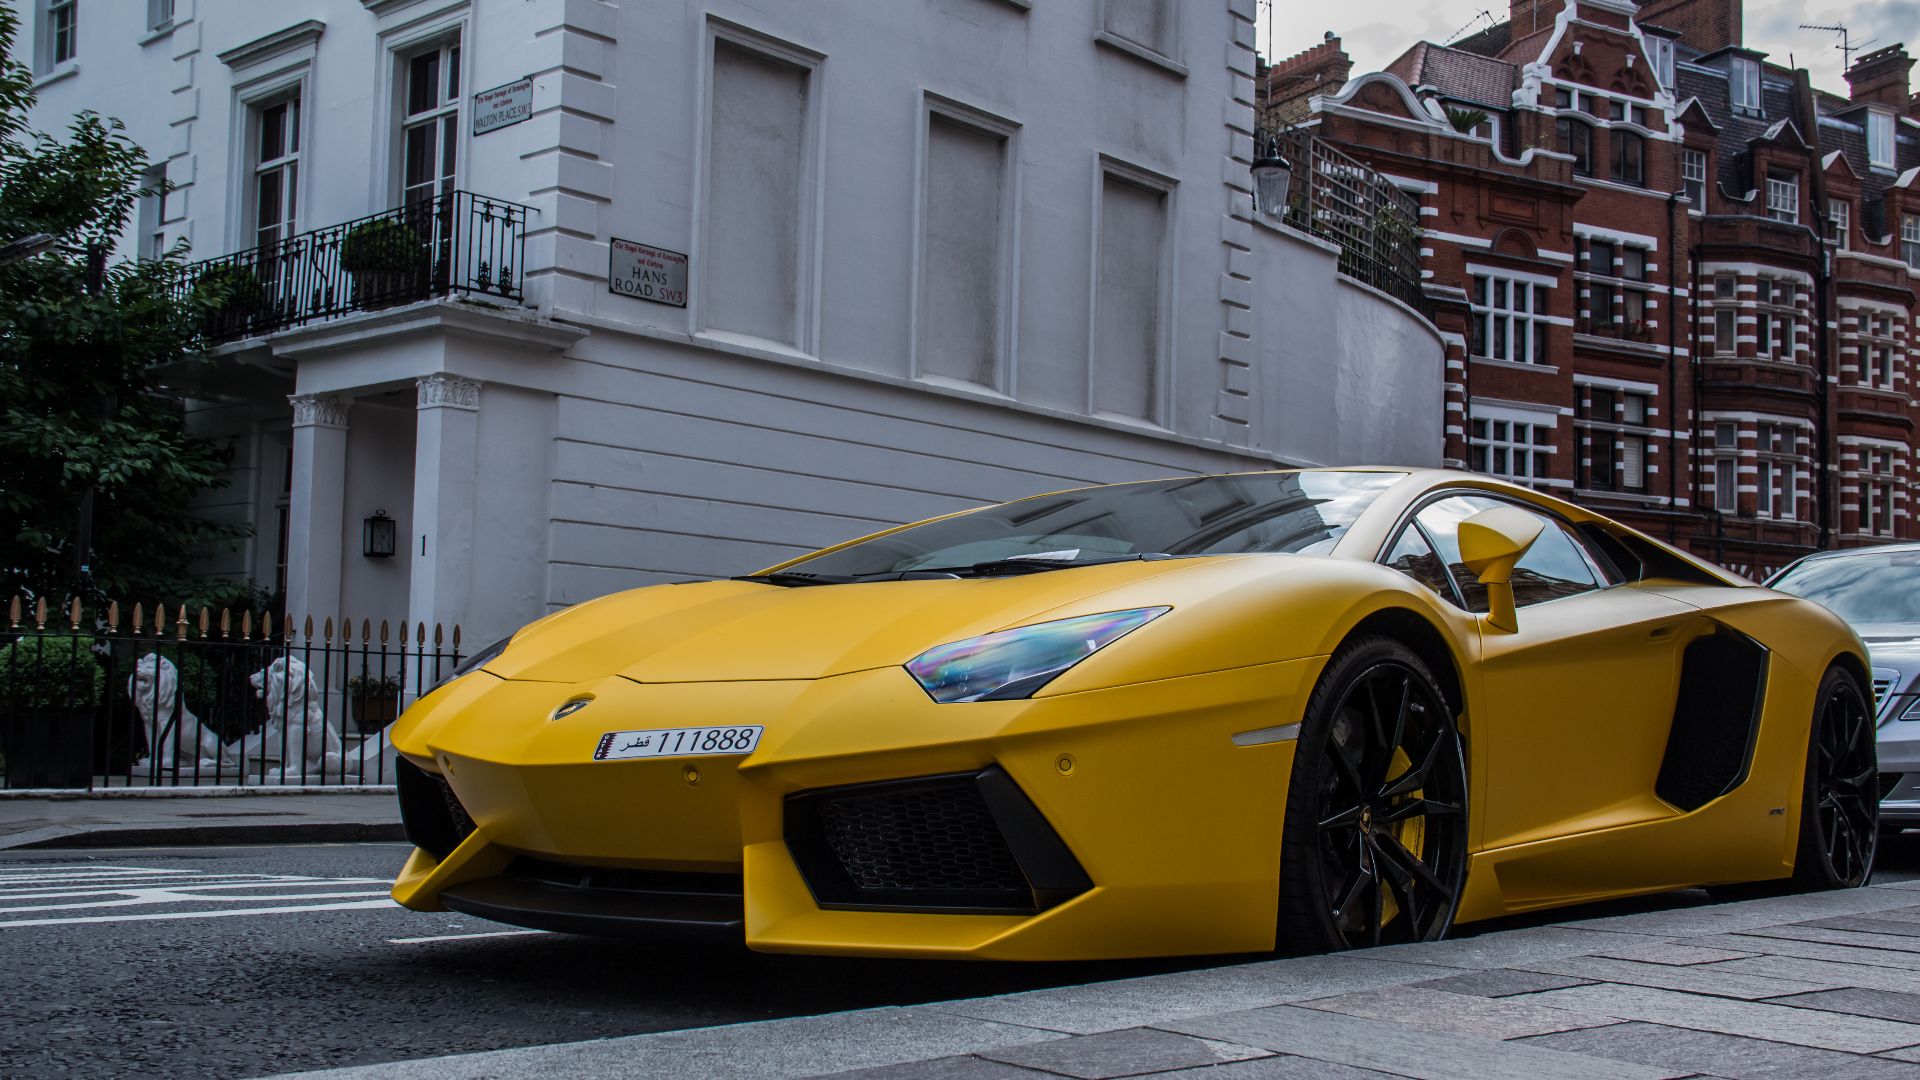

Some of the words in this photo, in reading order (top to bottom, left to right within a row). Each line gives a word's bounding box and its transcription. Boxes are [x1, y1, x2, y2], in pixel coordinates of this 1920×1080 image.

[475, 112, 498, 129] WALTON
[632, 266, 668, 286] HANS
[619, 736, 652, 752] قطر
[657, 728, 754, 753] 111888
